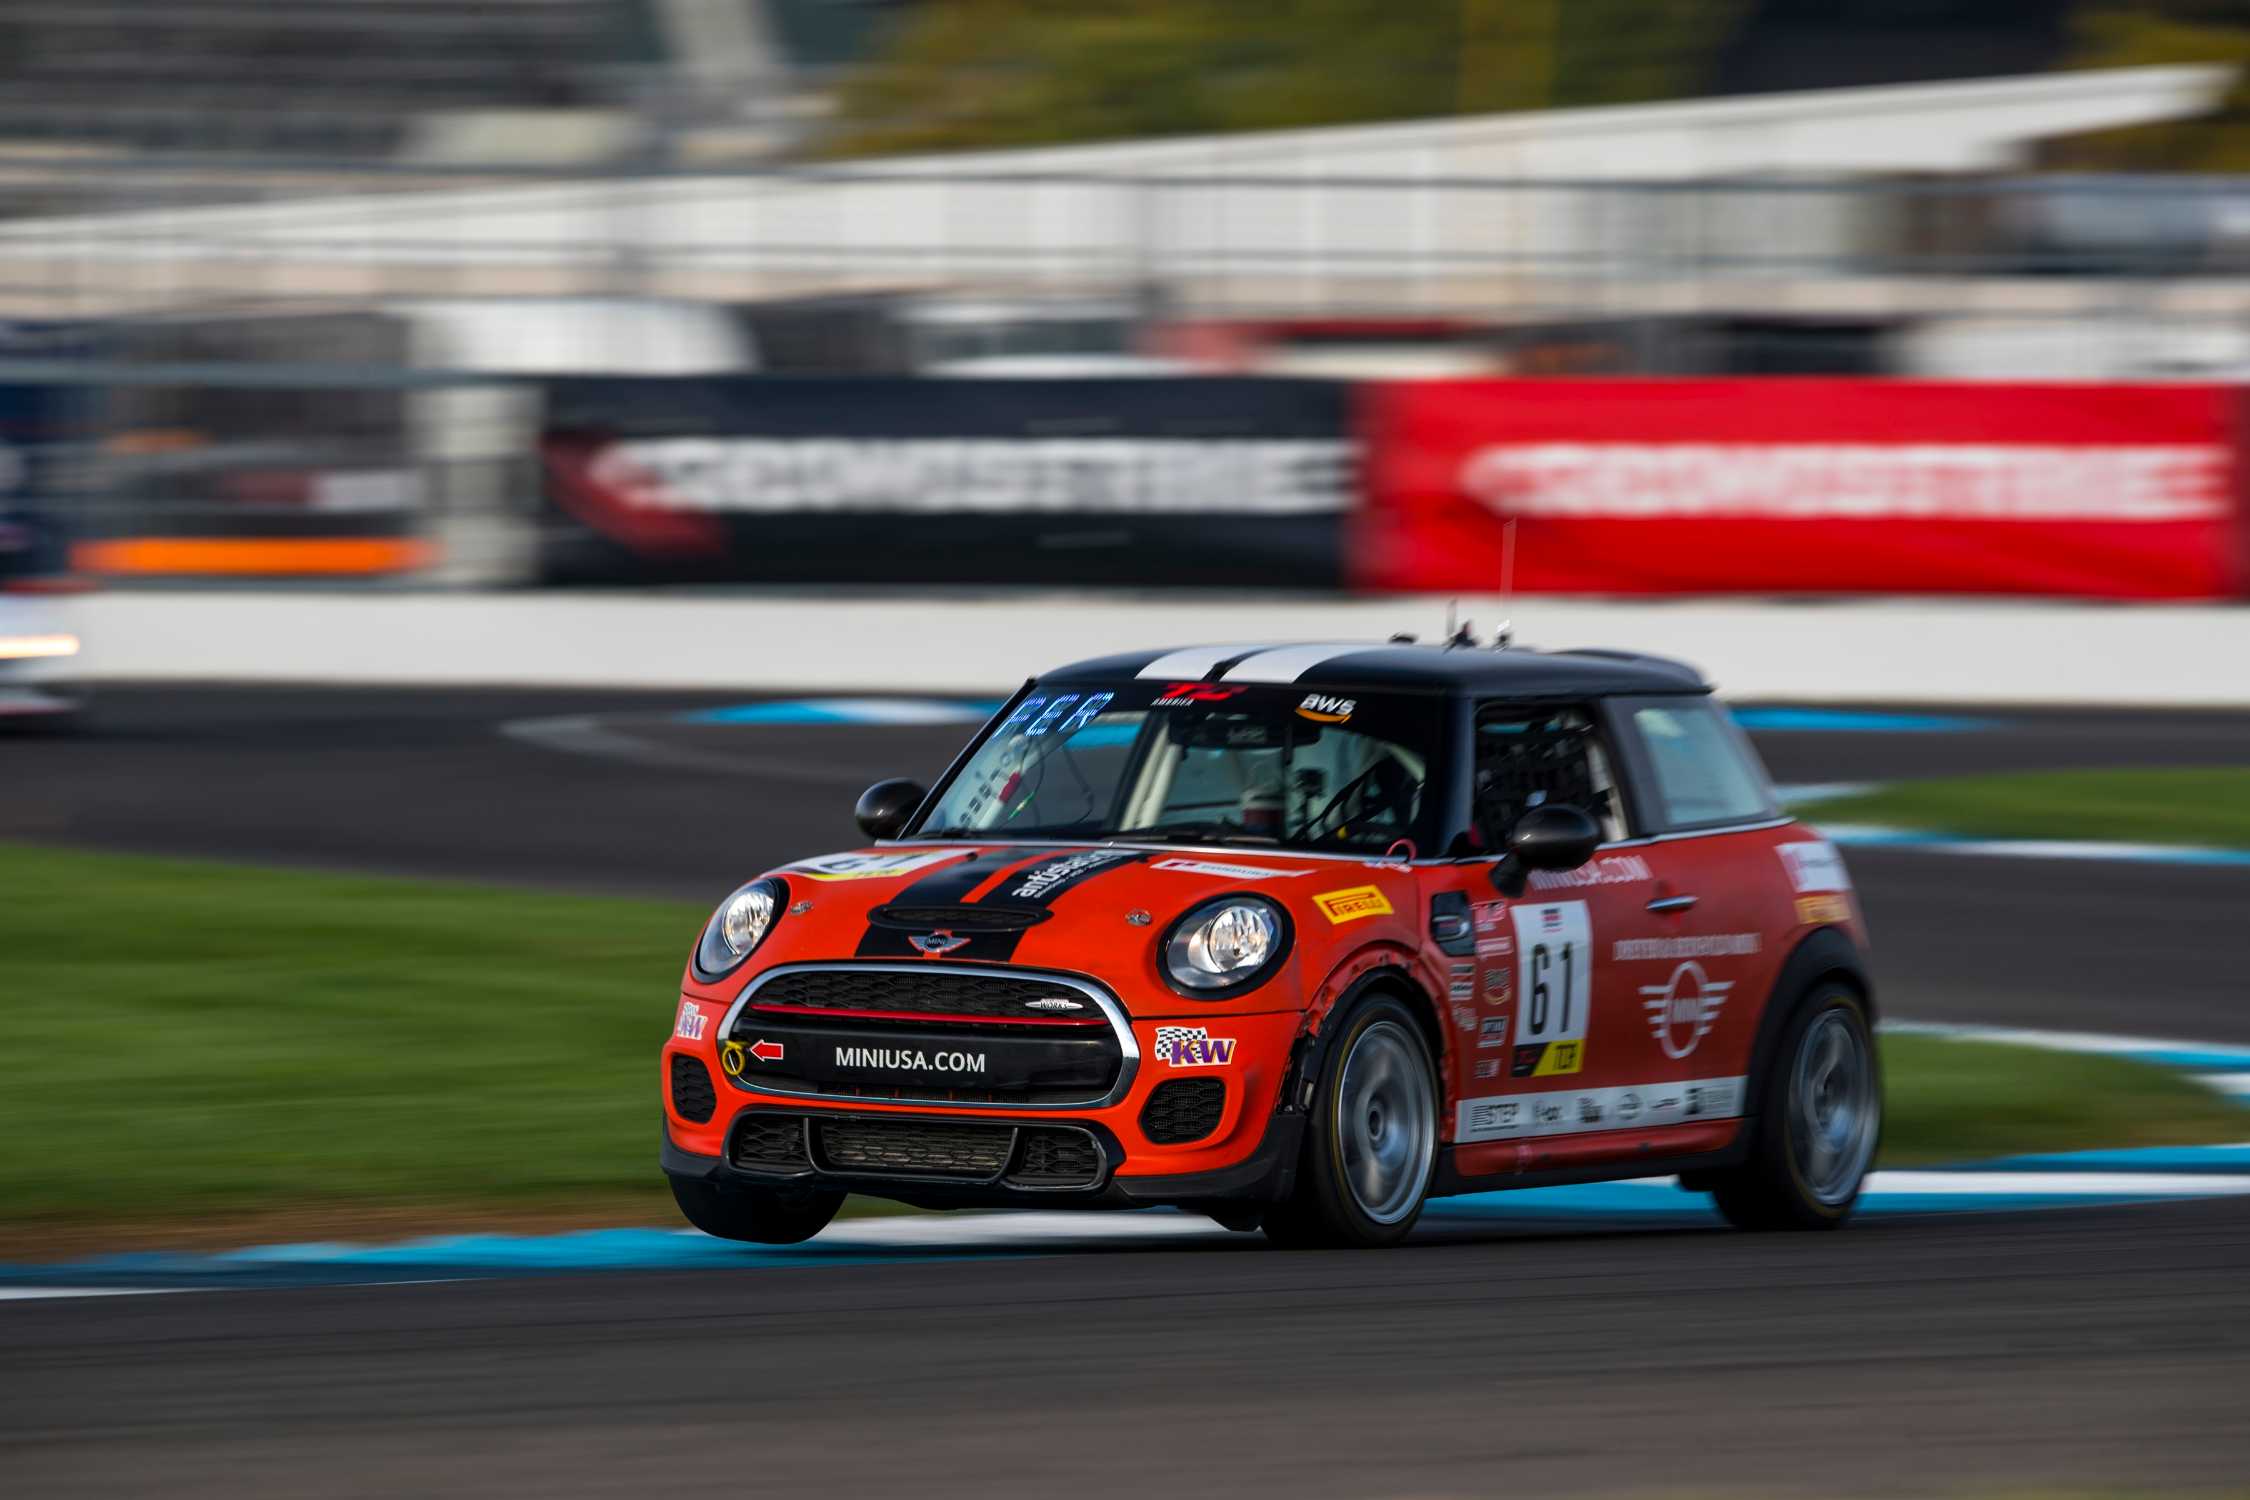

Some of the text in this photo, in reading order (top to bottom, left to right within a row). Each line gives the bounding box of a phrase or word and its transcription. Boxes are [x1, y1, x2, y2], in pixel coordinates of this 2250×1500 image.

[1529, 942, 1573, 1035] 61
[835, 1046, 986, 1073] MINIUSA.COM
[1170, 1038, 1235, 1066] KW
